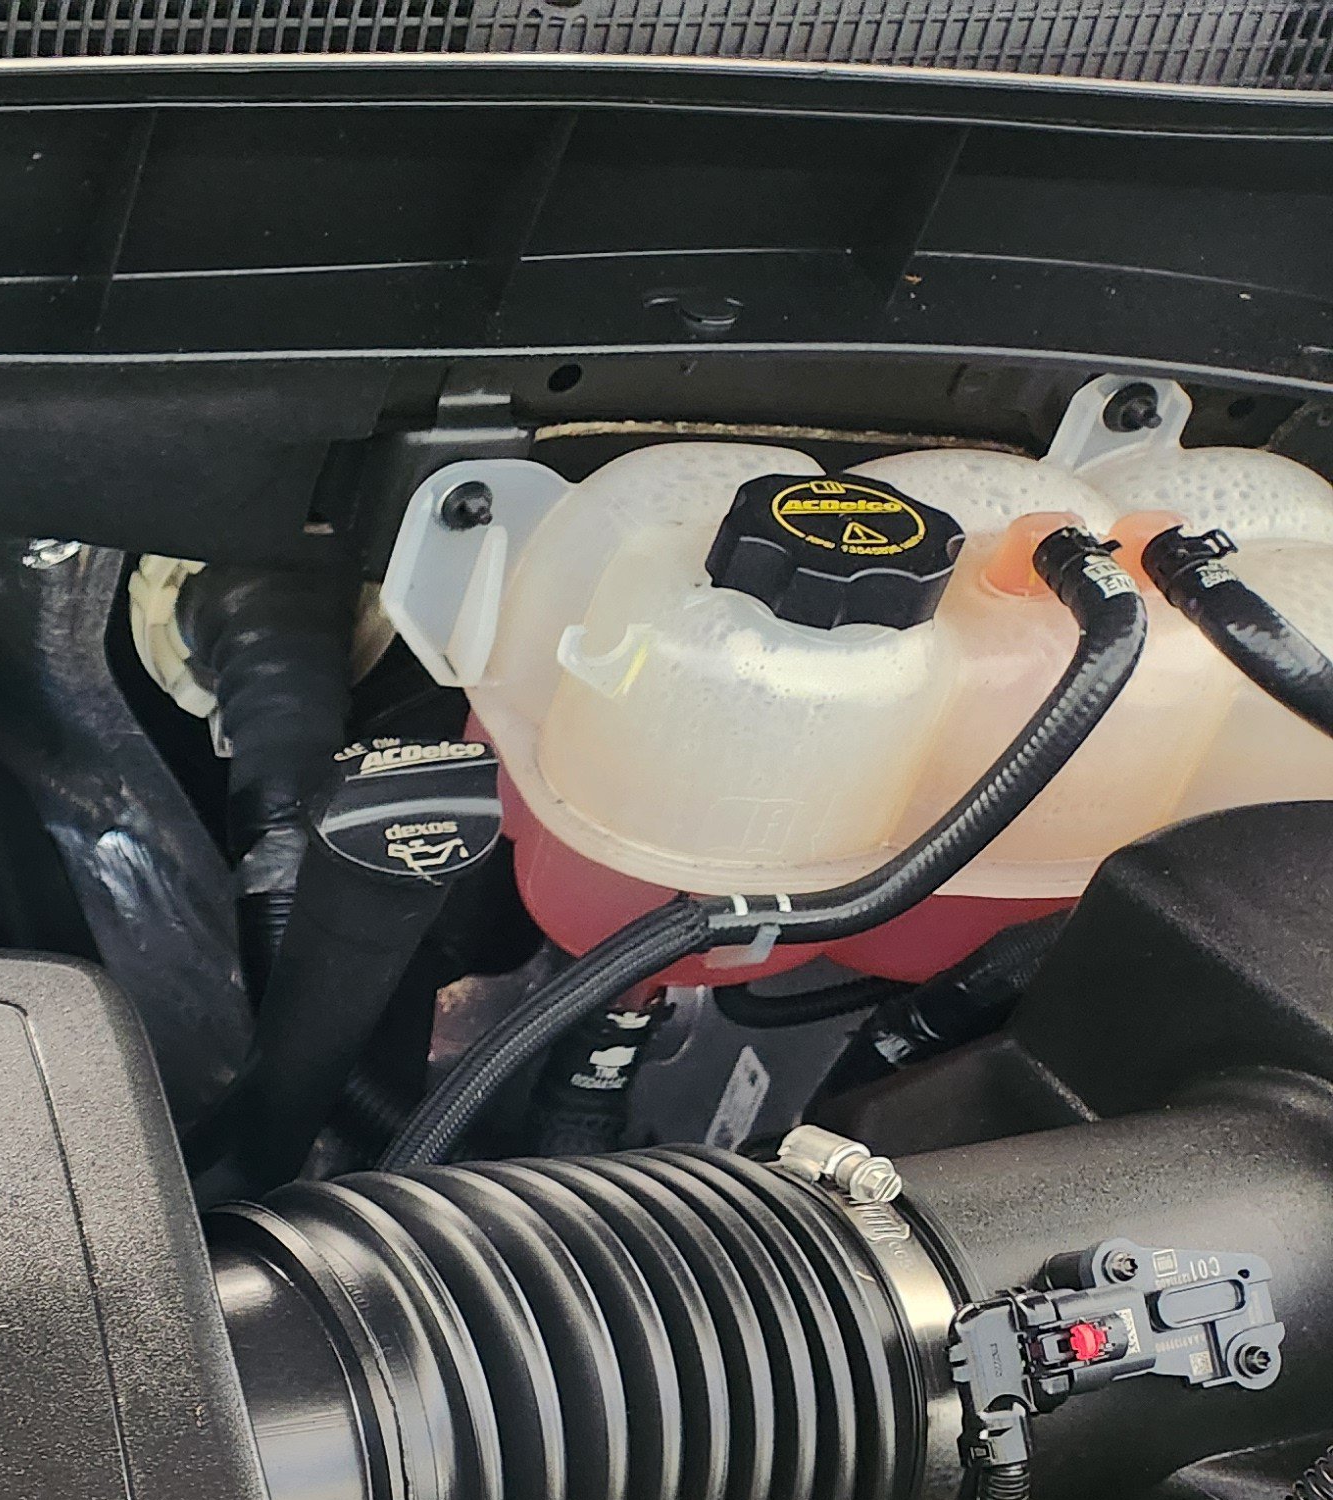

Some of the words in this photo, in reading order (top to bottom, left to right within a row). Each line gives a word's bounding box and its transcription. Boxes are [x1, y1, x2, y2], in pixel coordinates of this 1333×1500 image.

[780, 499, 903, 513] ACDelco
[360, 740, 486, 771] ACDelco
[385, 821, 458, 841] dexos
[1189, 1256, 1222, 1282] C01
